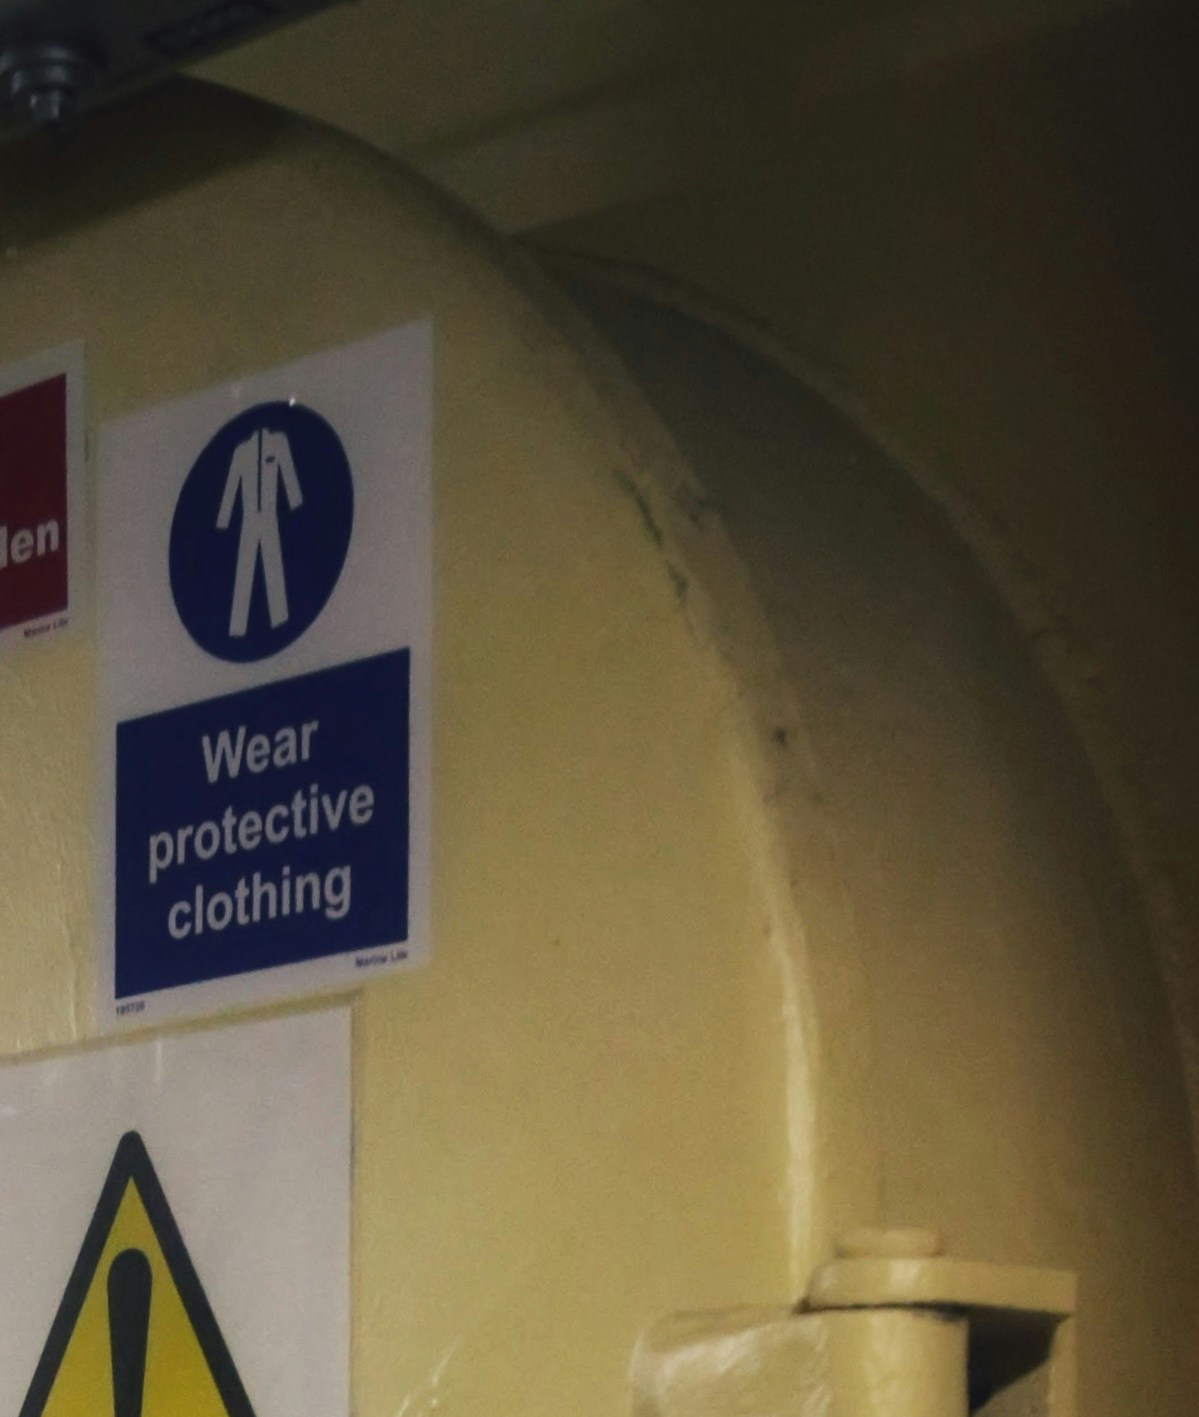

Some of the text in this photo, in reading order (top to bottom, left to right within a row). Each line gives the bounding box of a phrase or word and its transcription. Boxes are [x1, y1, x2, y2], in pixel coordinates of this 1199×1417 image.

[201, 719, 320, 784] Wear
[148, 783, 375, 885] protective
[167, 864, 351, 940] clothing
